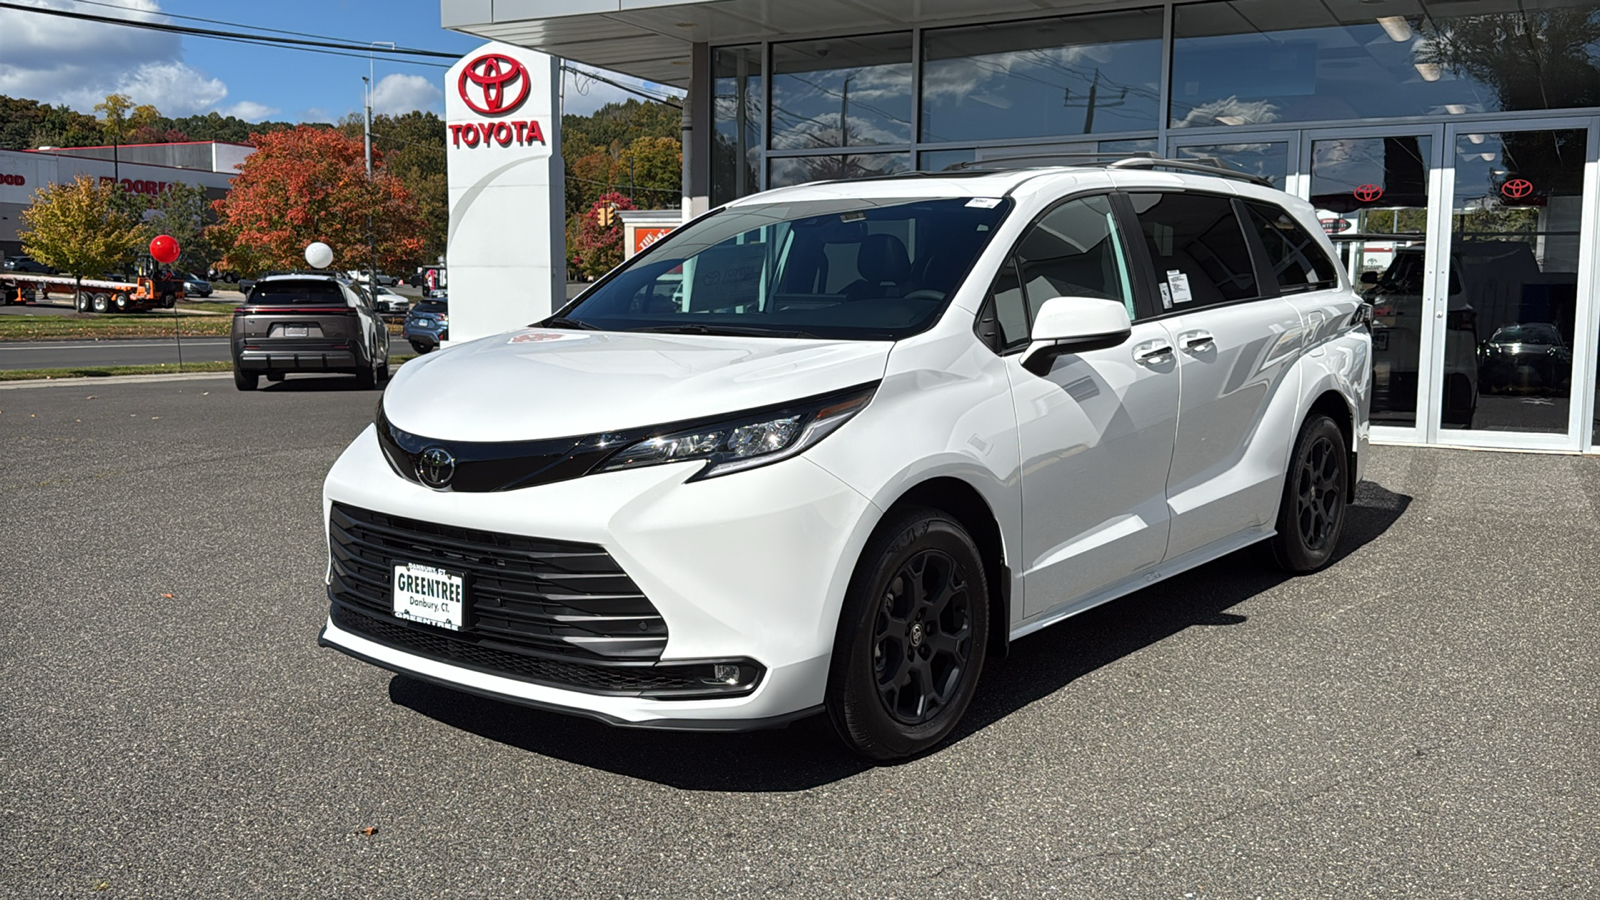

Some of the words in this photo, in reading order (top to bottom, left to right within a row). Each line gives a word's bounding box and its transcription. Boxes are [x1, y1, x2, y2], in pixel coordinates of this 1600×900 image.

[448, 120, 546, 148] TOYOTA
[397, 572, 461, 604] GREENTREE
[409, 595, 439, 613] Danbury,
